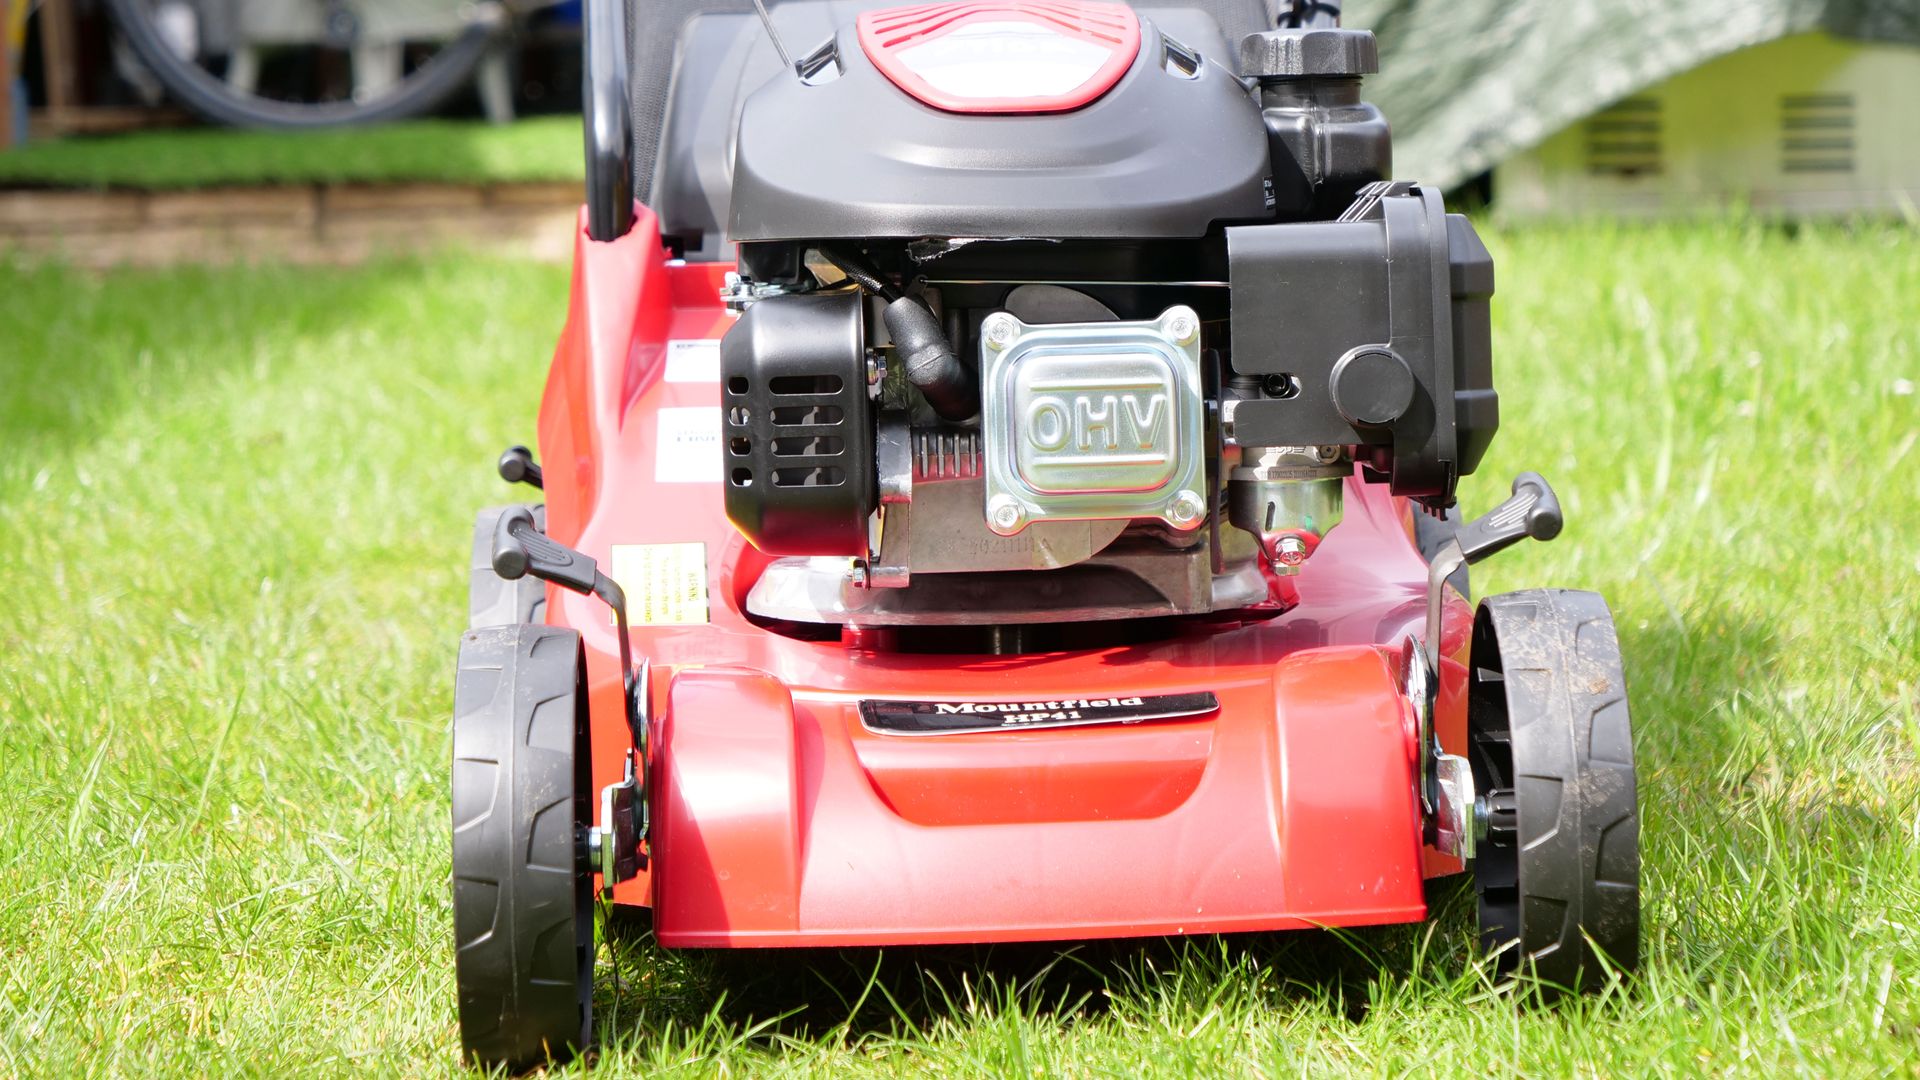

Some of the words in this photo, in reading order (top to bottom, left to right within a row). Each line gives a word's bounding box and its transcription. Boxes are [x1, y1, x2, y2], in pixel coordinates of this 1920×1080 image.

[1027, 393, 1167, 452] OHV
[934, 697, 1144, 714] Mountfield
[1003, 710, 1082, 724] HP41
